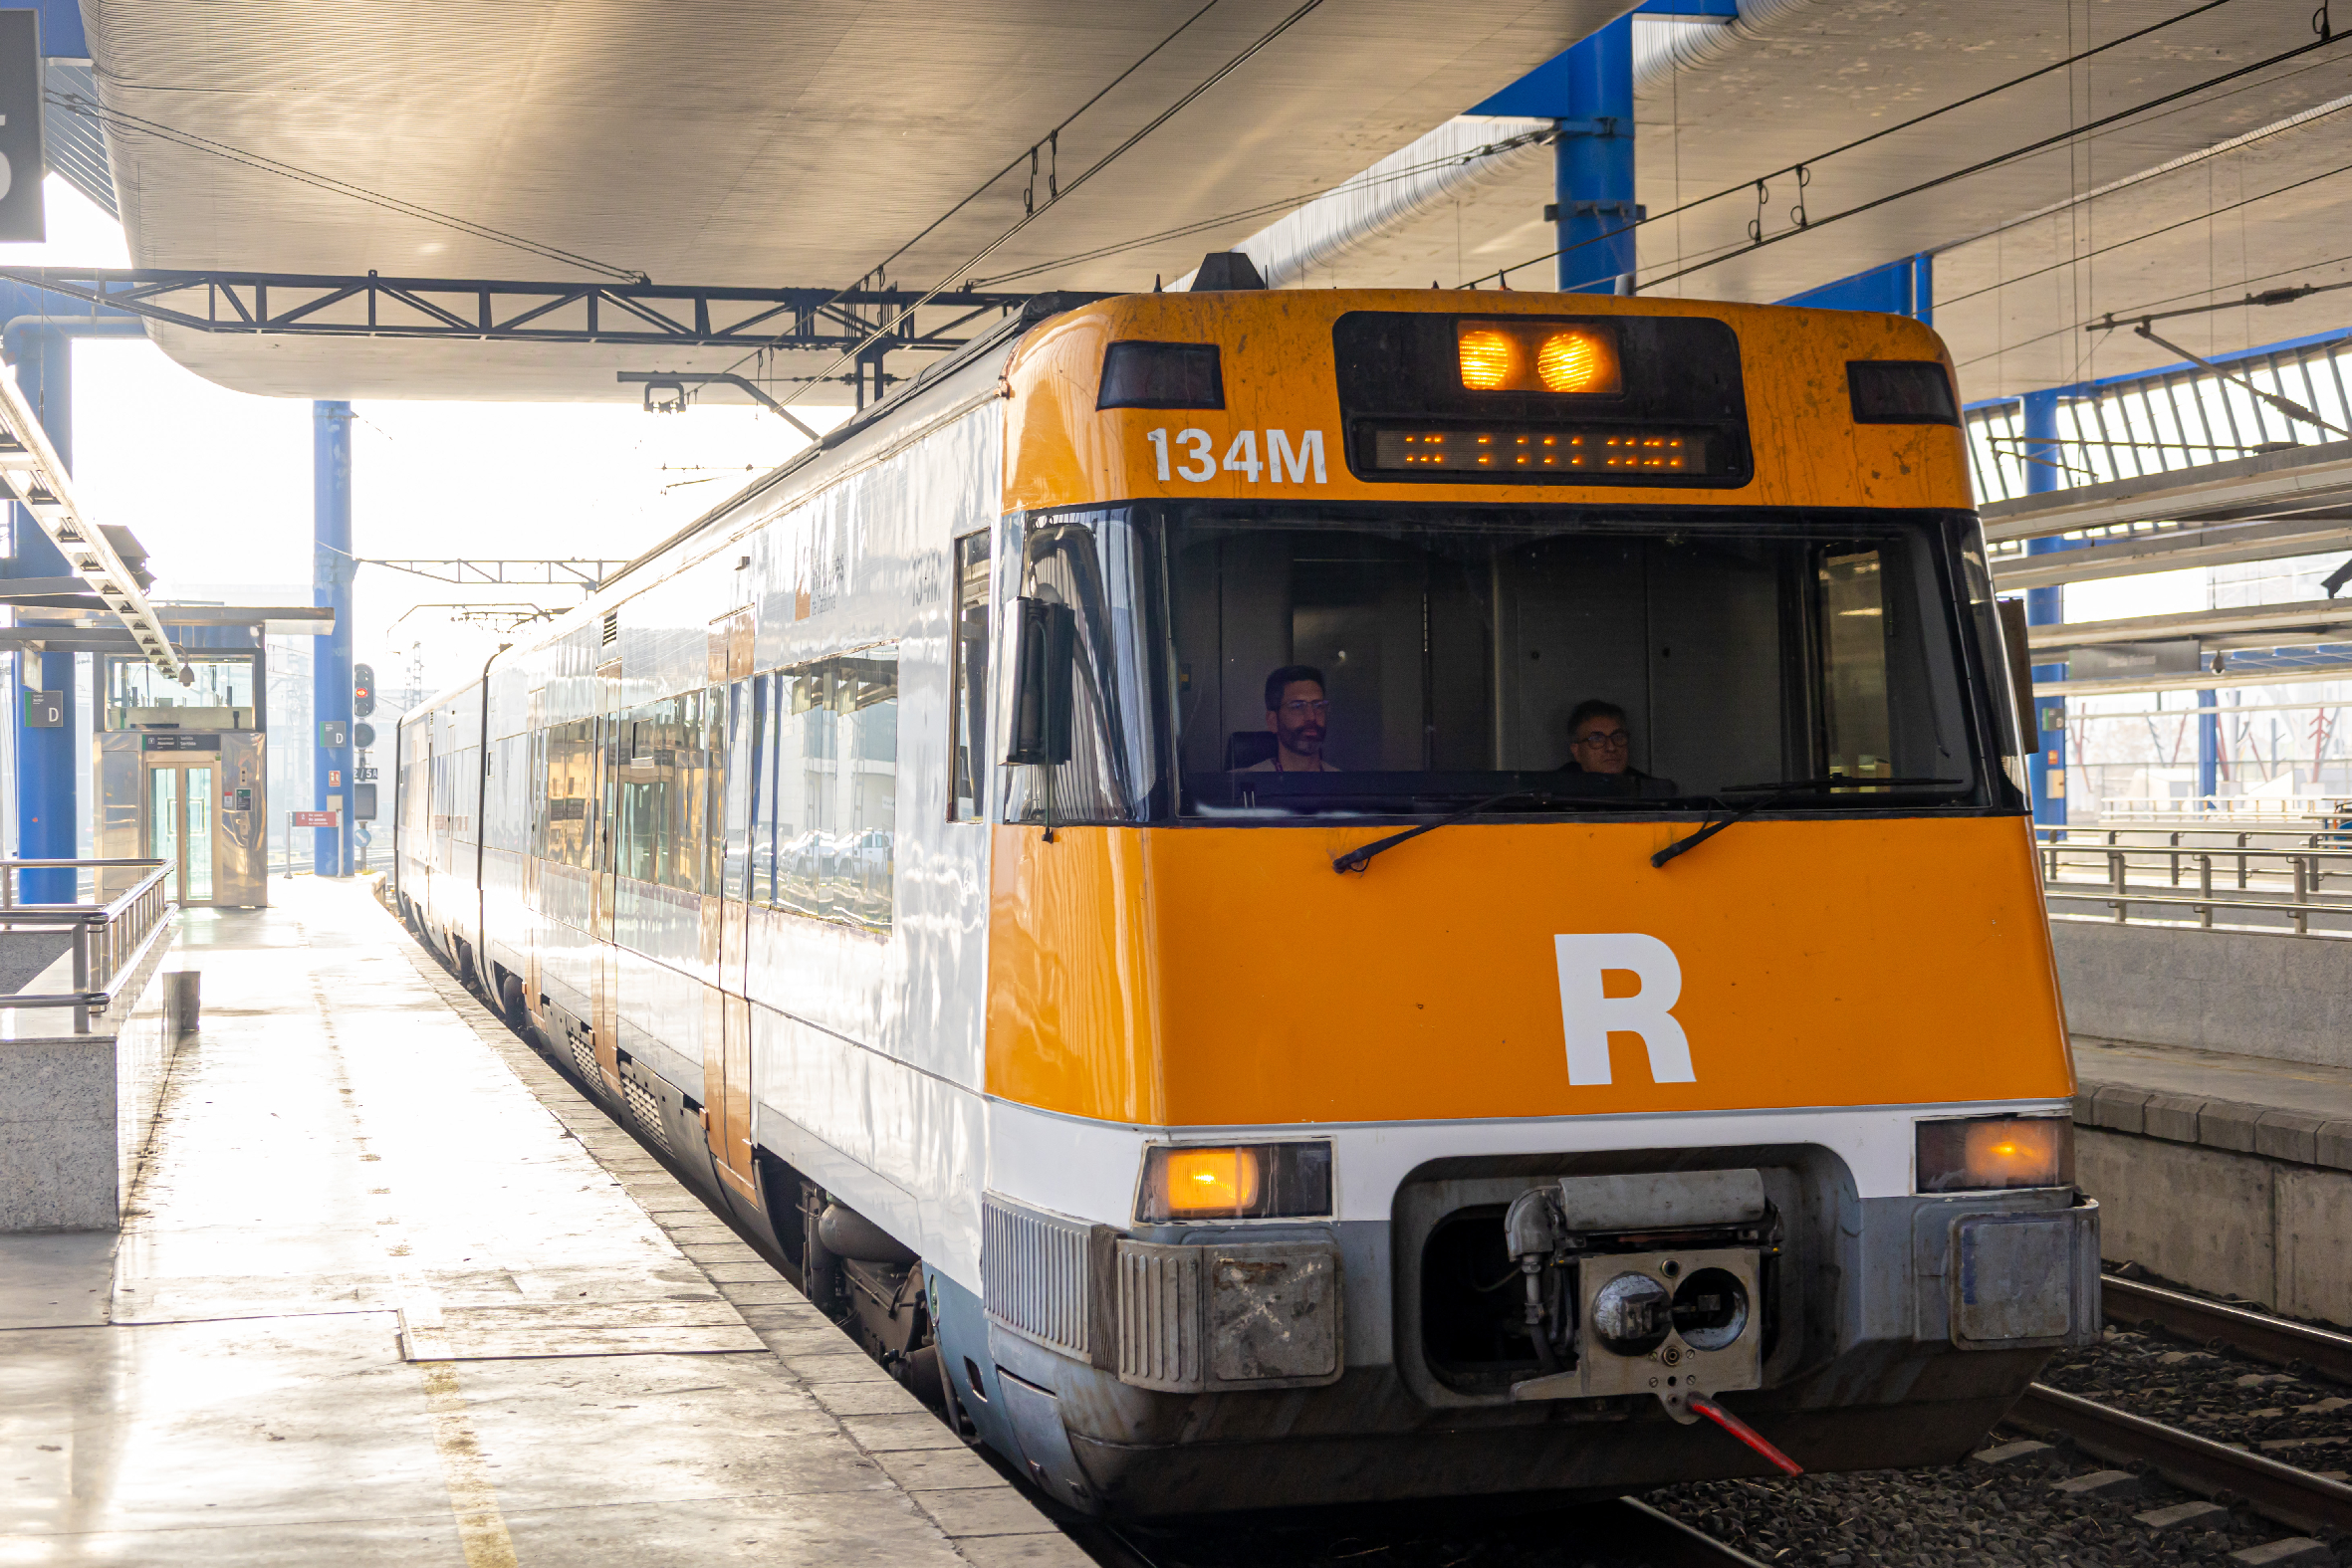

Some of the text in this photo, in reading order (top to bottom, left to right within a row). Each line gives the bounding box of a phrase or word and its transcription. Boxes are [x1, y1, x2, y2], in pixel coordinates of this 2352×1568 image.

[1147, 428, 1327, 484] 134M
[48, 707, 59, 722] D
[336, 733, 344, 744] D
[1553, 933, 1697, 1086] R
